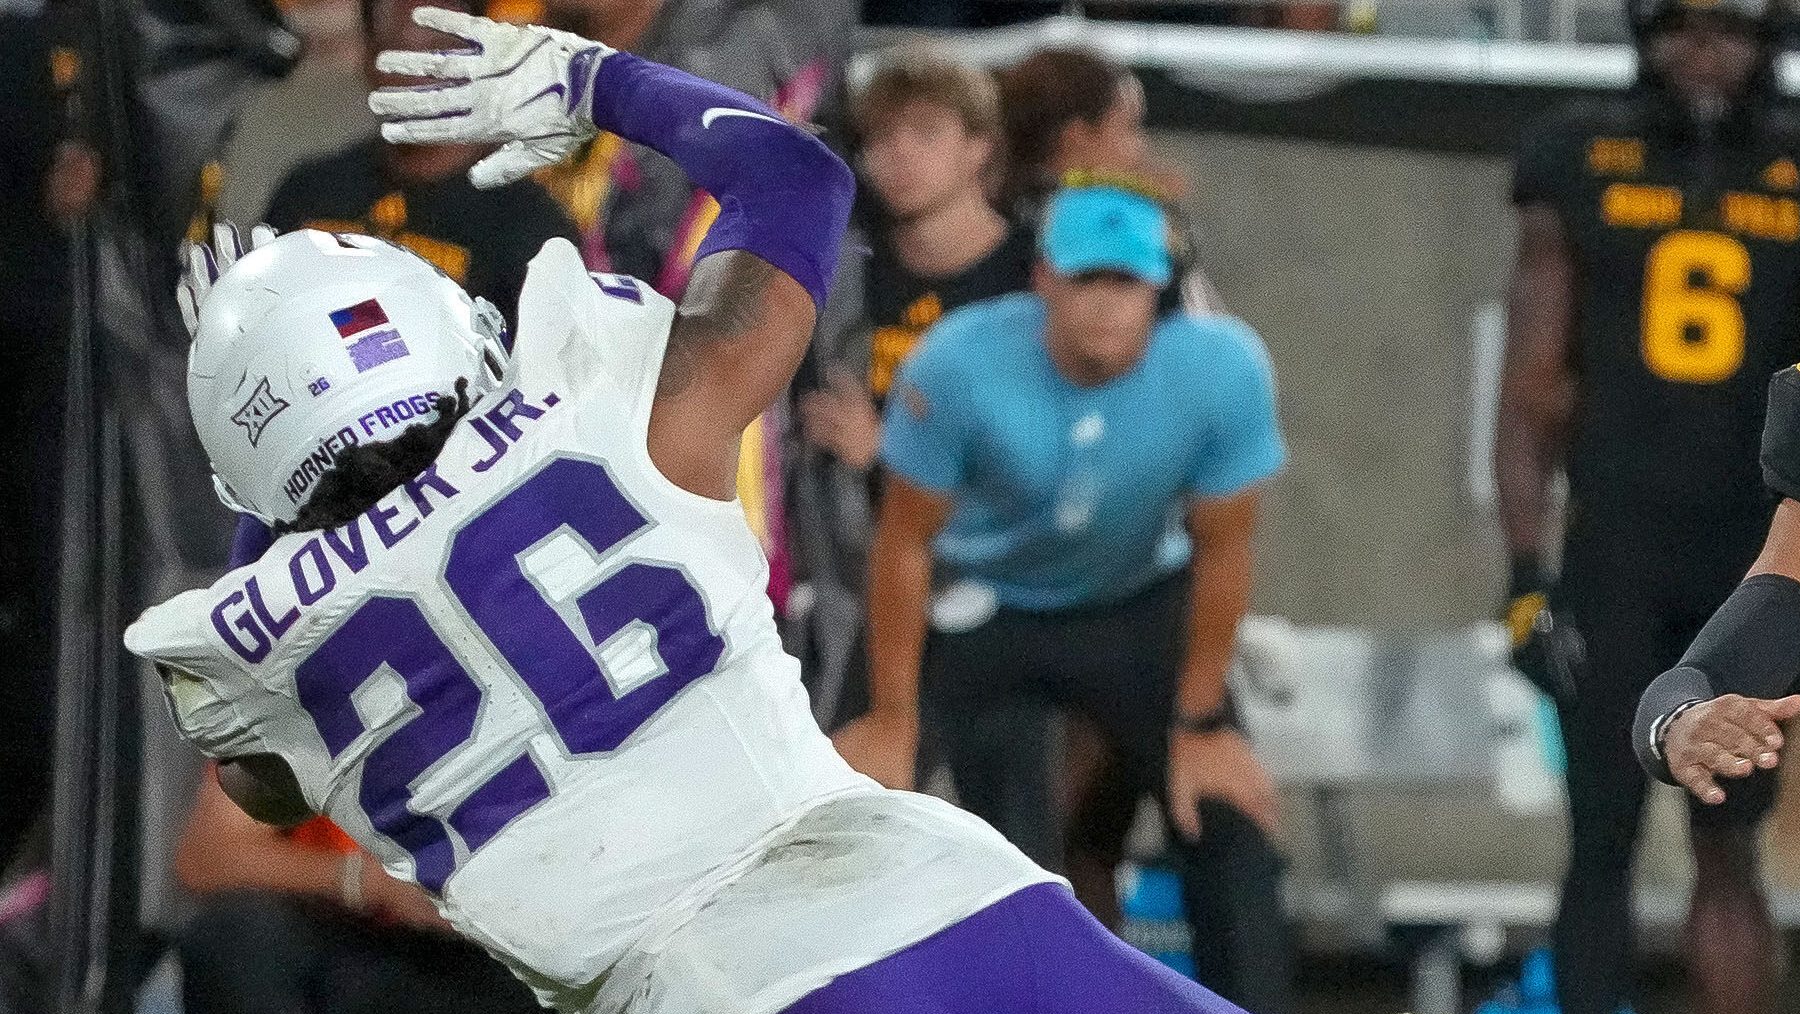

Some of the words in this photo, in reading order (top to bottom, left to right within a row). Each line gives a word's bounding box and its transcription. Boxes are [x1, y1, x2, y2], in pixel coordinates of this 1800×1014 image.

[1642, 231, 1752, 384] 6
[283, 425, 360, 505] HORNED
[357, 391, 443, 438] FROGS
[307, 376, 331, 397] 26
[210, 461, 460, 664] GLOVER
[470, 387, 562, 473] JR.
[294, 450, 729, 899] 26
